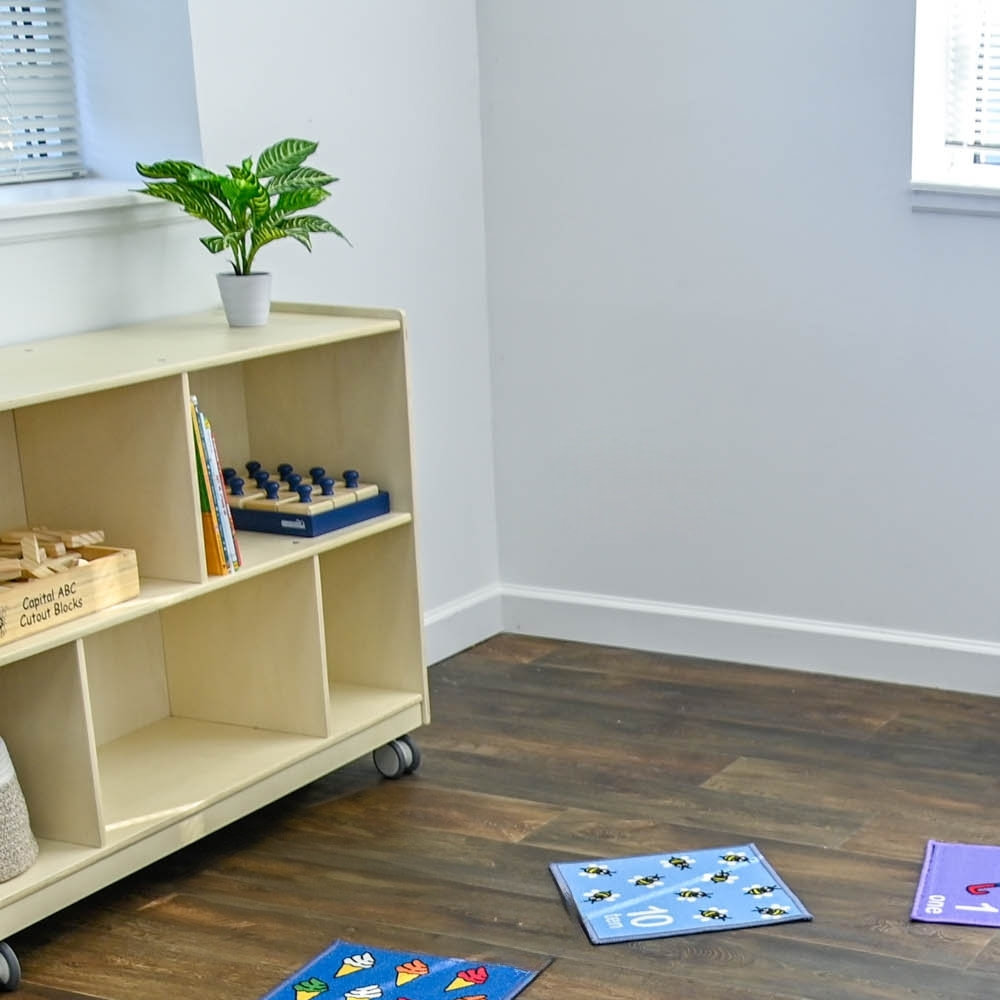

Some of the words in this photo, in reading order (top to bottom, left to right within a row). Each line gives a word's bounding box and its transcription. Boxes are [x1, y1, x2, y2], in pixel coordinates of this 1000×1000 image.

[22, 588, 55, 611] Capital
[57, 582, 77, 598] ABC
[20, 609, 51, 627] Cutout
[54, 597, 84, 616] Blocks
[925, 894, 946, 914] one
[955, 902, 999, 913] 1
[626, 905, 674, 928] 10
